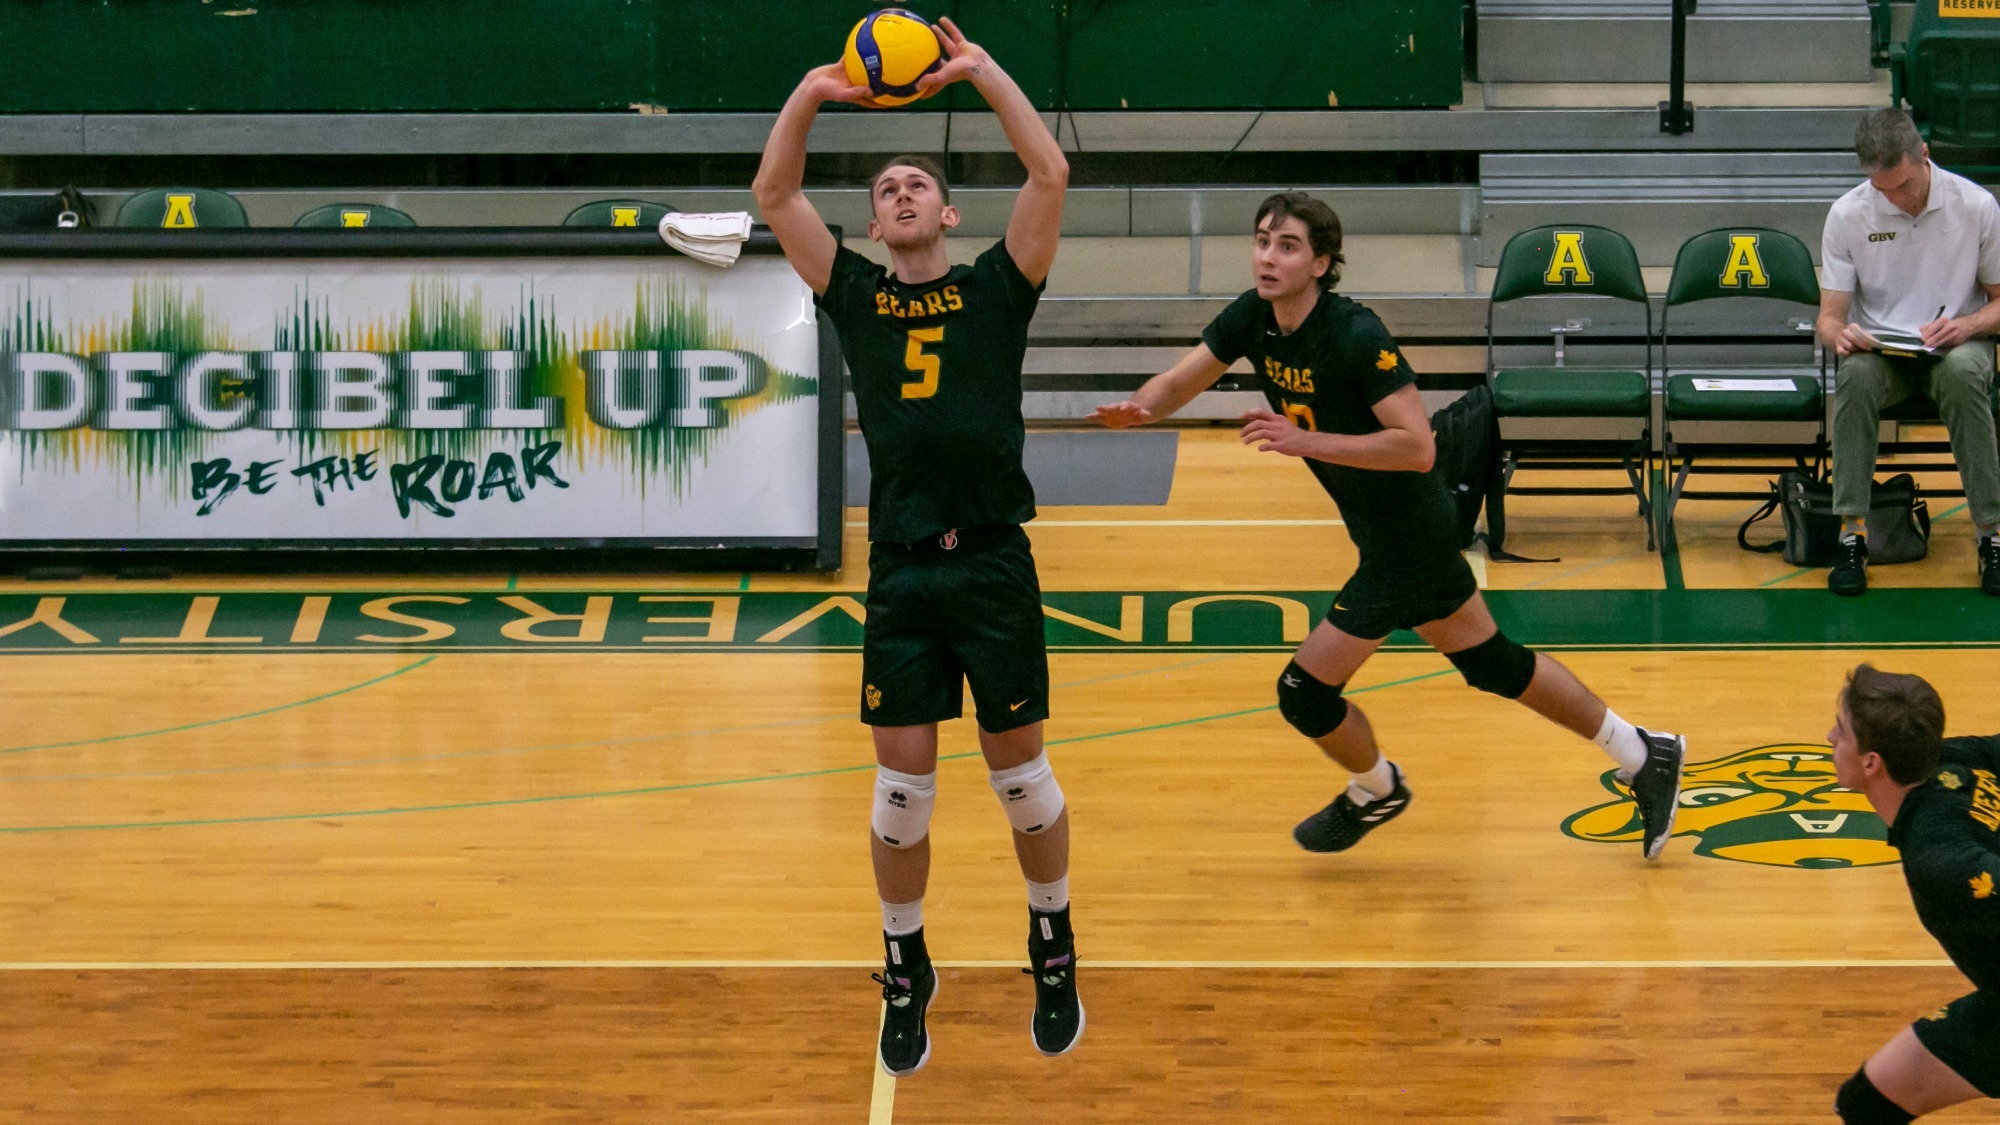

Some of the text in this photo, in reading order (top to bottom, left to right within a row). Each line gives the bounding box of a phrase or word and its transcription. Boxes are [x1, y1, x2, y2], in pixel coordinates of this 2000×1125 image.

[1544, 231, 1594, 285] A
[1719, 234, 1770, 288] A
[1868, 232, 1896, 242] GBV
[875, 285, 963, 318] BEARS
[901, 326, 944, 399] 5
[12, 350, 769, 430] DECIBEL UP
[190, 441, 570, 519] BE THE ROAR
[1789, 813, 1849, 834] A
